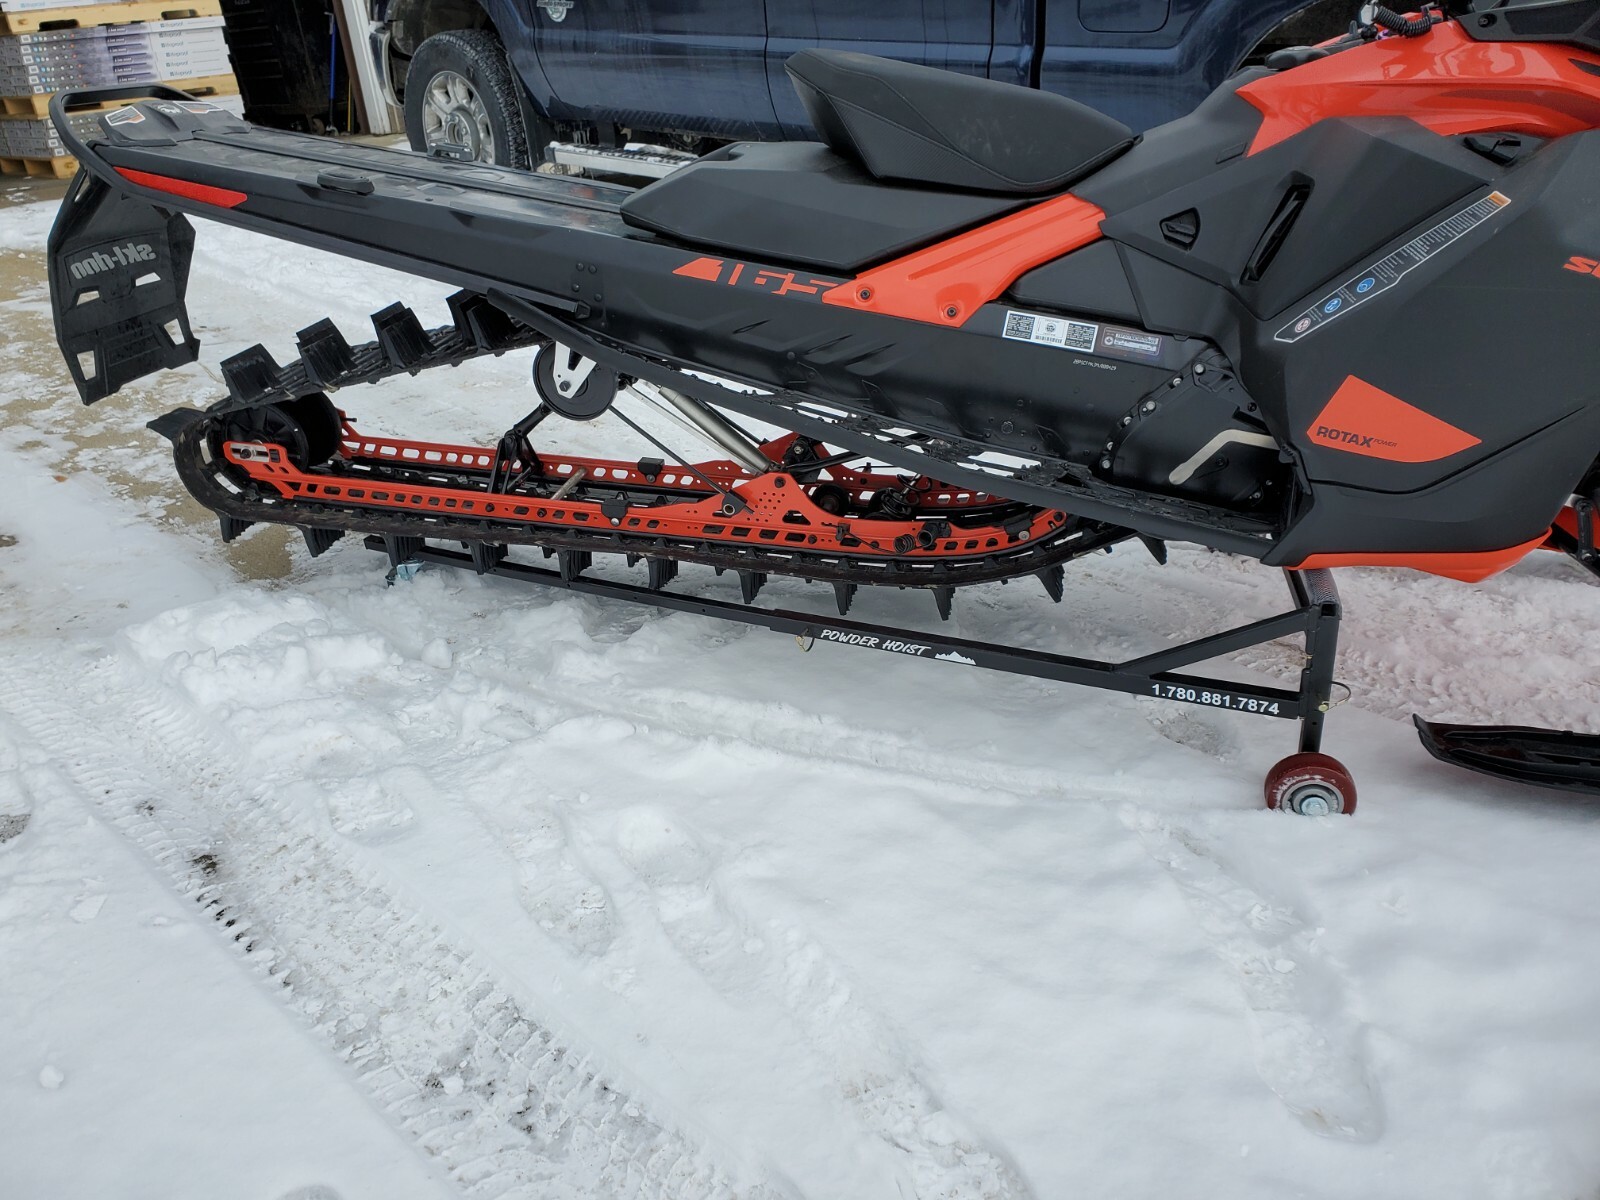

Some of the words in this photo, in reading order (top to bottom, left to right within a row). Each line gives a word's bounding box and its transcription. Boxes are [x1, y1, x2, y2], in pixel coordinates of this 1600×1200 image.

[1316, 425, 1375, 448] ROTAX
[1371, 438, 1398, 448] POWER
[820, 629, 880, 648] POWDER
[882, 639, 932, 656] HOIST
[1151, 683, 1280, 715] 1.780.881.7874
